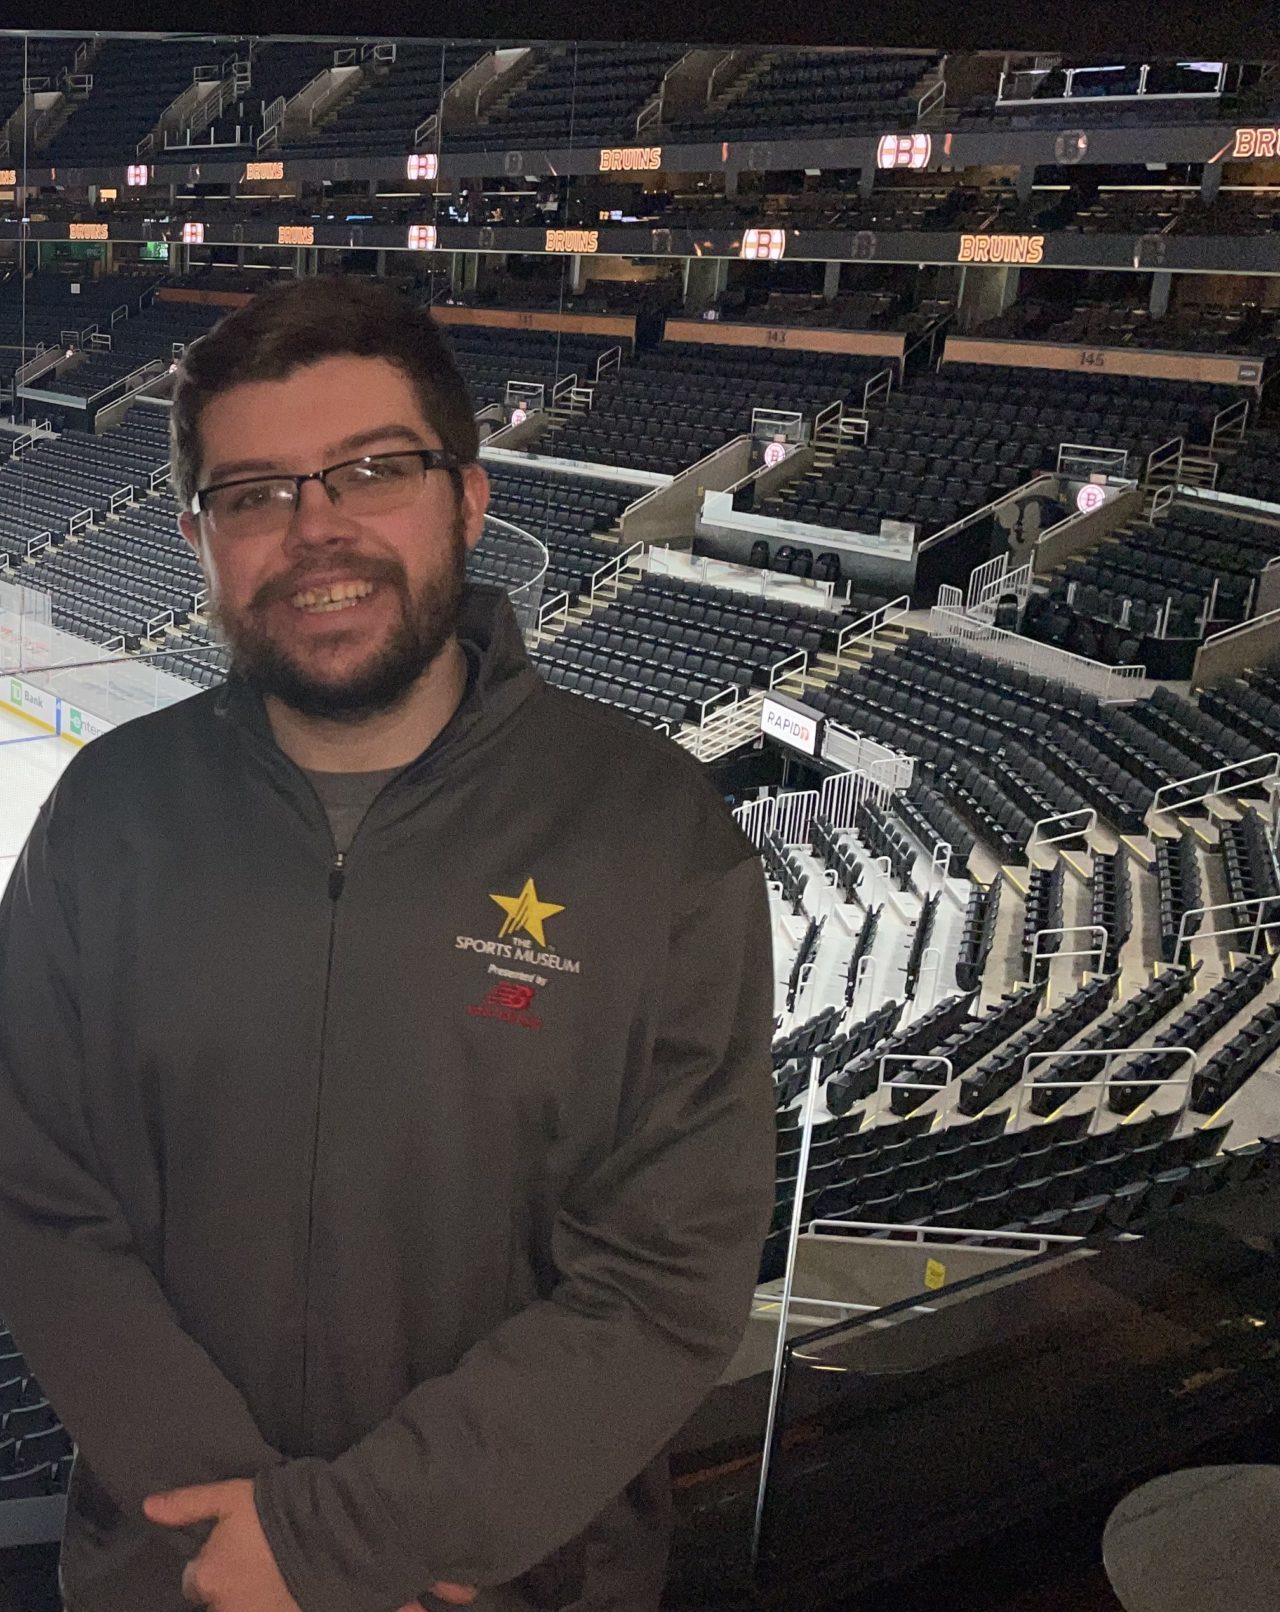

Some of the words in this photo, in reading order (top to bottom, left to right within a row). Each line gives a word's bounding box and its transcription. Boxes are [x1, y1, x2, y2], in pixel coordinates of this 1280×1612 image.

[1232, 128, 1280, 157] BR
[599, 147, 662, 171] BRUINS
[246, 162, 284, 180] BRUINS
[68, 223, 109, 239] BRUINS
[278, 226, 314, 245] BRUINS
[545, 229, 599, 253] BRUINS
[958, 235, 1044, 262] BRUINS
[24, 690, 43, 708] Bank
[512, 937, 532, 949] THE
[455, 935, 512, 958] SPORTS
[513, 948, 581, 974] MUSEUM
